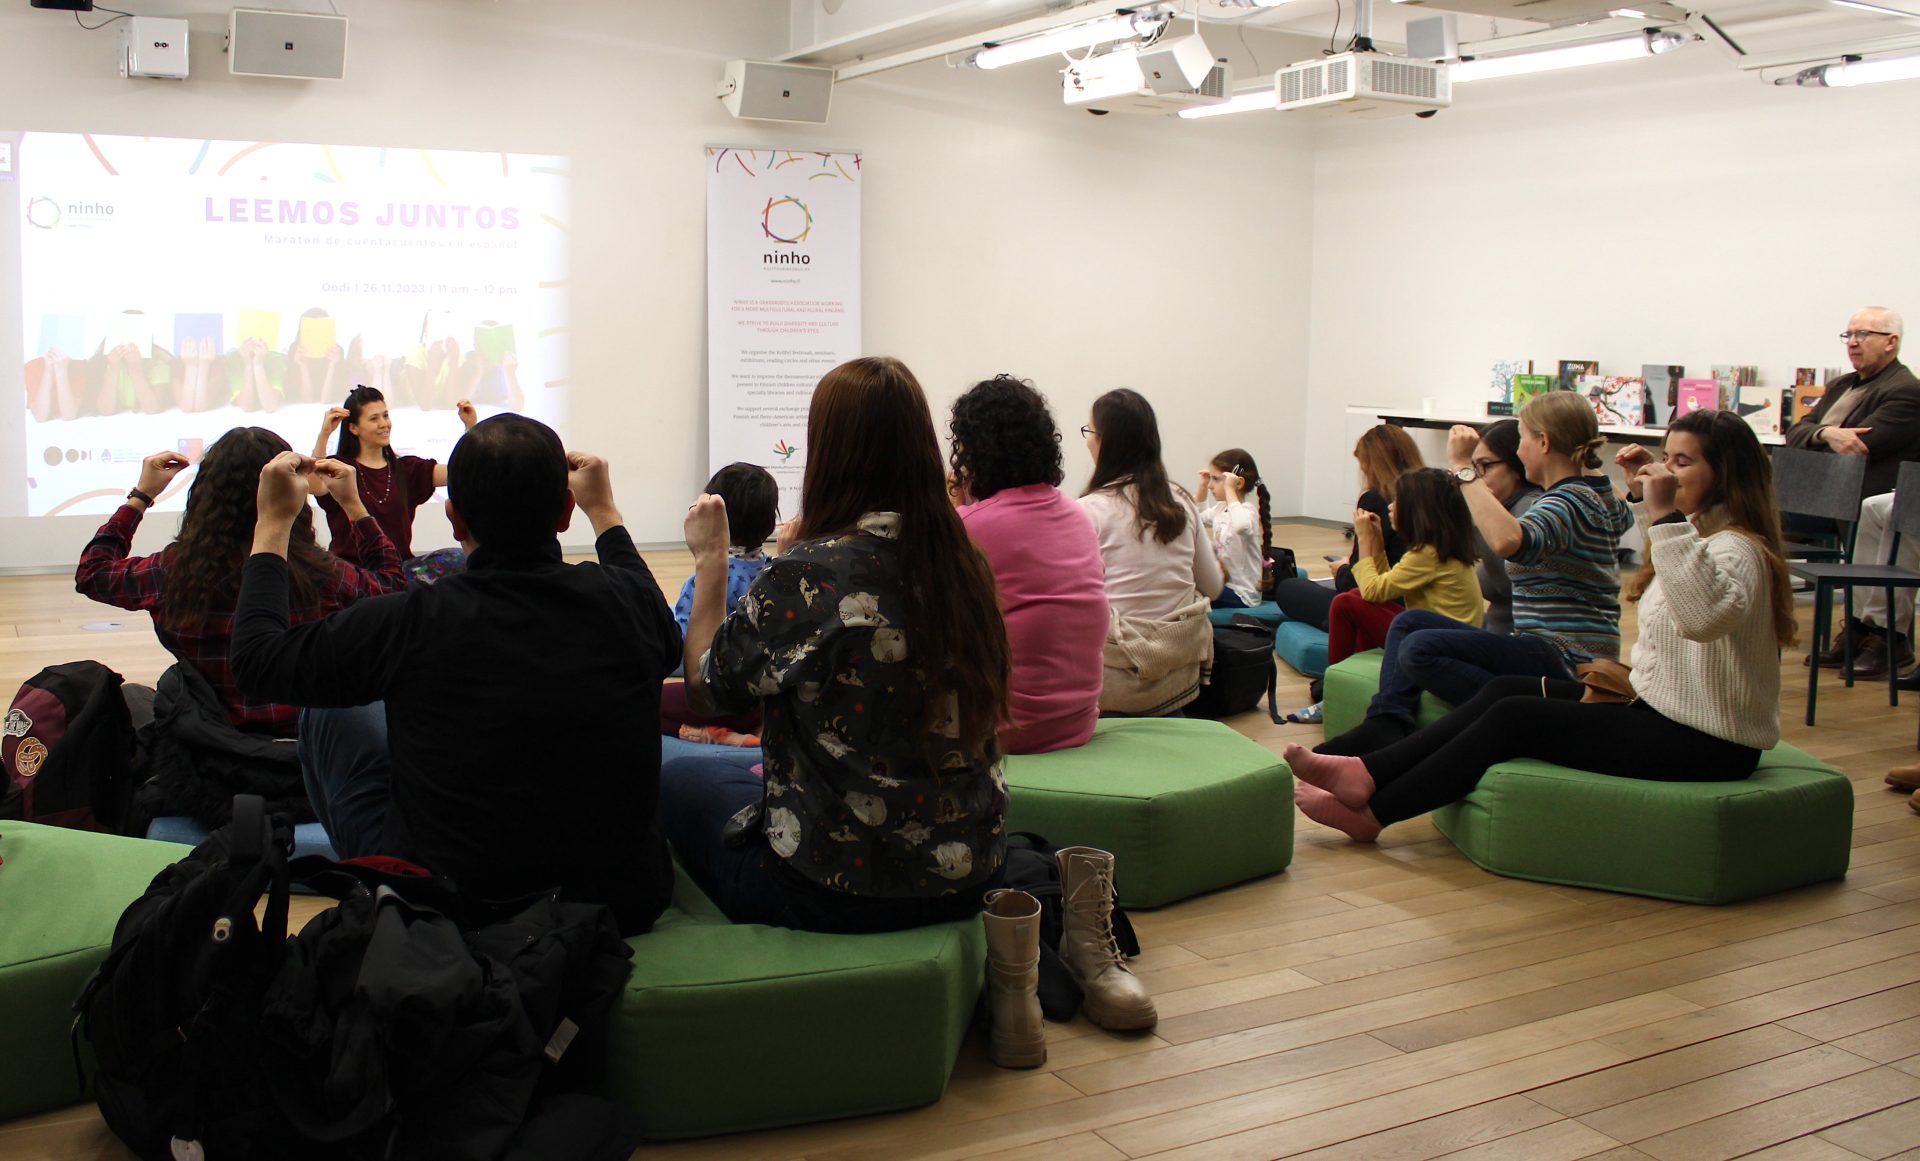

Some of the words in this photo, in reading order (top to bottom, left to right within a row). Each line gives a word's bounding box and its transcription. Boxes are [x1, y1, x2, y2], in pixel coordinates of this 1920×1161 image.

[69, 201, 114, 215] ninho
[204, 197, 359, 226] LEEMOS
[375, 203, 520, 230] JUNTOS
[264, 233, 320, 246] Maratón
[325, 235, 341, 246] de
[347, 236, 444, 248] cuentacuentos
[448, 239, 464, 248] en
[469, 238, 519, 251] español
[764, 250, 810, 264] ninho
[321, 282, 351, 293] Oodi
[363, 282, 426, 294] 26.11.2023
[437, 283, 448, 294] 11
[451, 285, 469, 294] am
[483, 284, 496, 295] 12
[498, 286, 519, 296] pm
